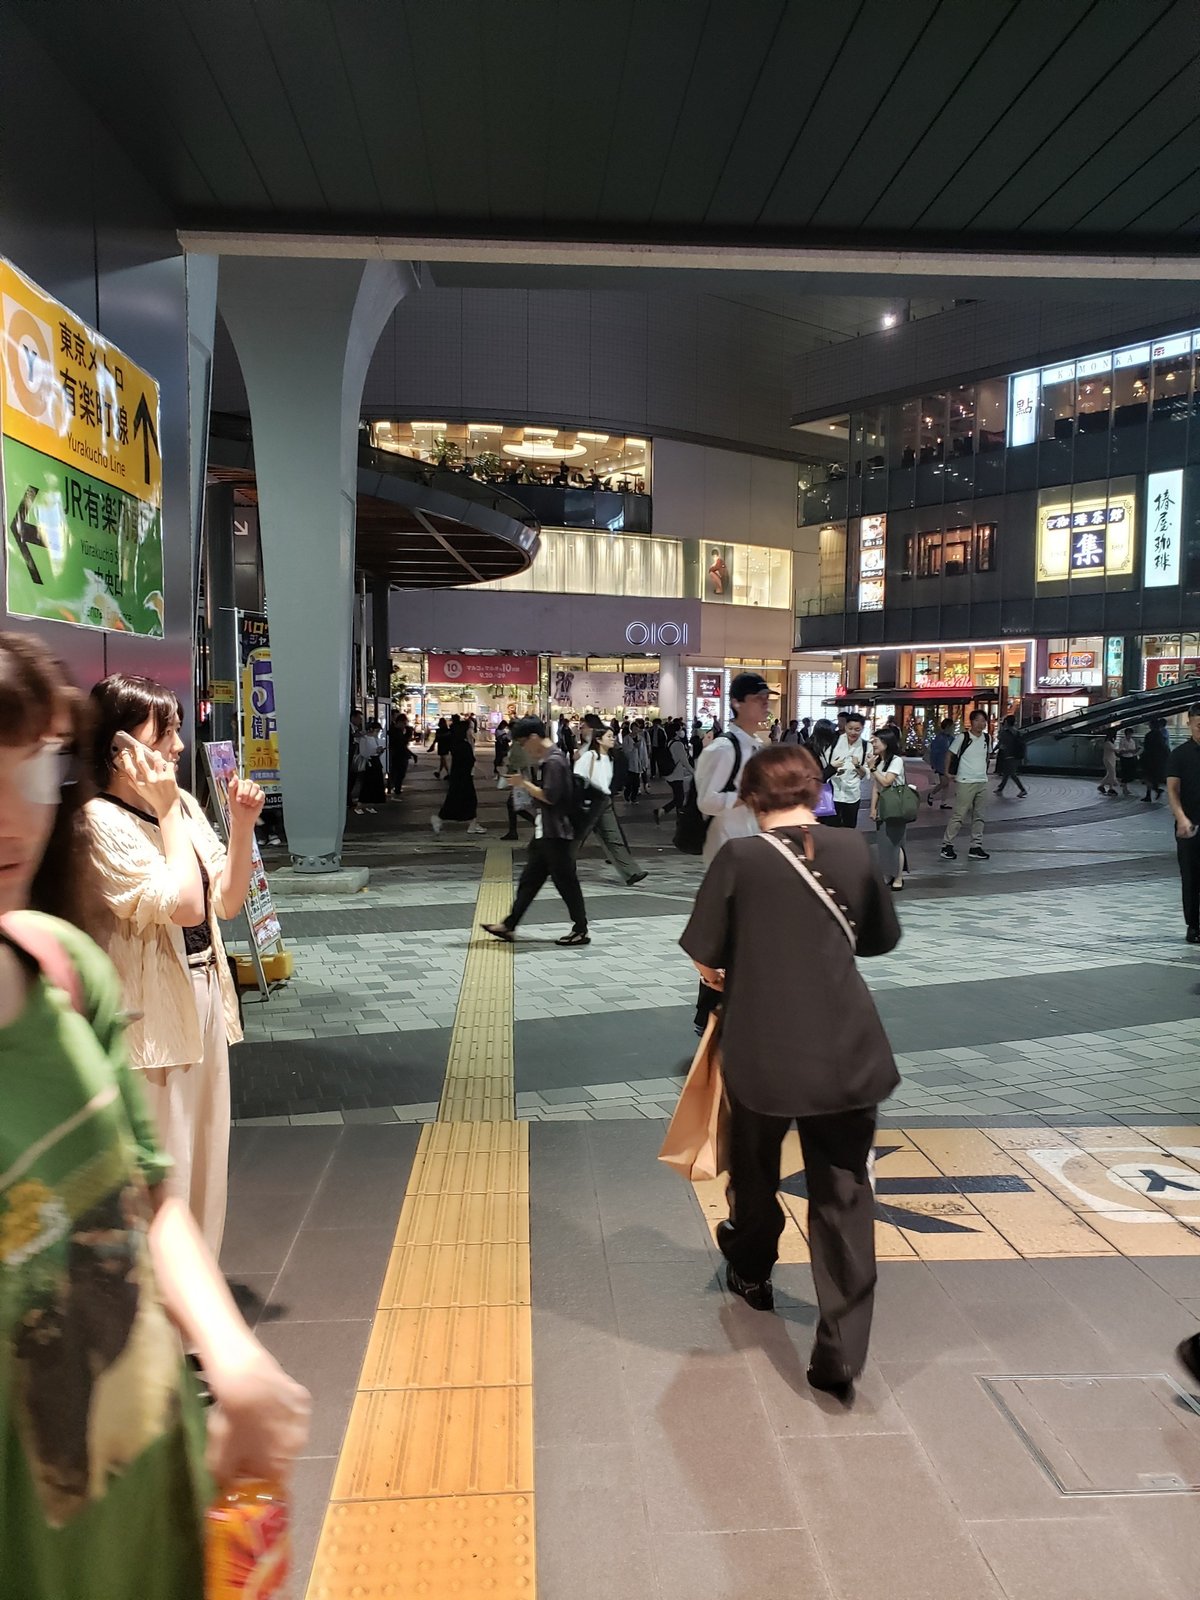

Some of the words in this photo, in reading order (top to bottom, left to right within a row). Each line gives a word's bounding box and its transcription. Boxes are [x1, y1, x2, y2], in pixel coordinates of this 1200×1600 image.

[58, 320, 125, 392] 東京メトロ
[109, 455, 126, 477] Line
[1073, 533, 1103, 566] 集
